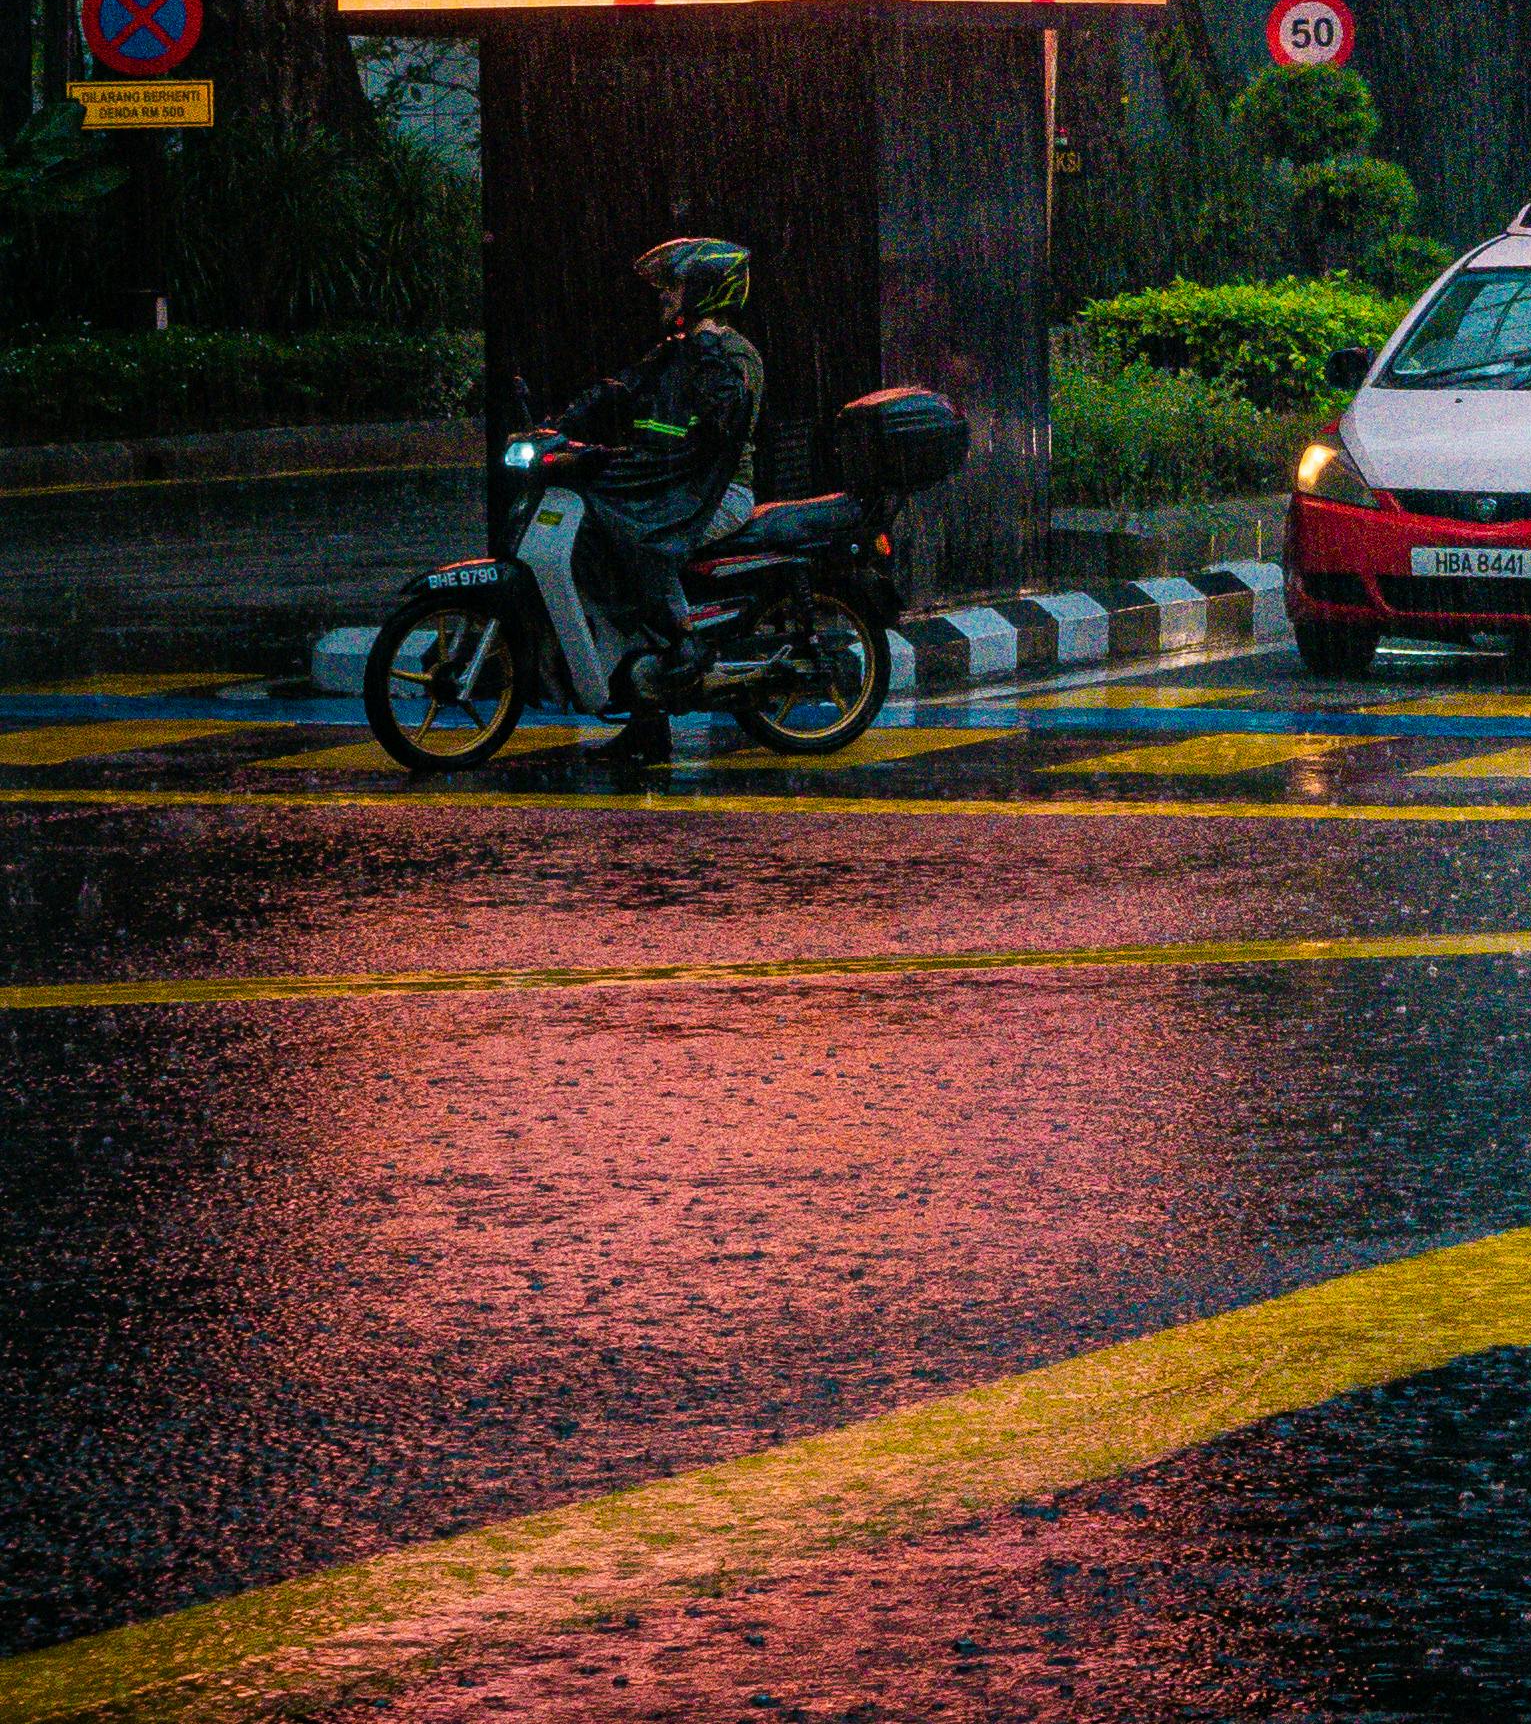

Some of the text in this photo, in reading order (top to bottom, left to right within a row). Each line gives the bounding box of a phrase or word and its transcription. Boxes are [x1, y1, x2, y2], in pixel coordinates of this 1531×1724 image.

[1292, 18, 1334, 49] 50
[81, 90, 200, 103] DILARANG BERHENTI
[99, 106, 185, 118] DENDA RM 500
[1435, 551, 1524, 575] HBA 8441
[428, 566, 498, 589] BHE 9790
